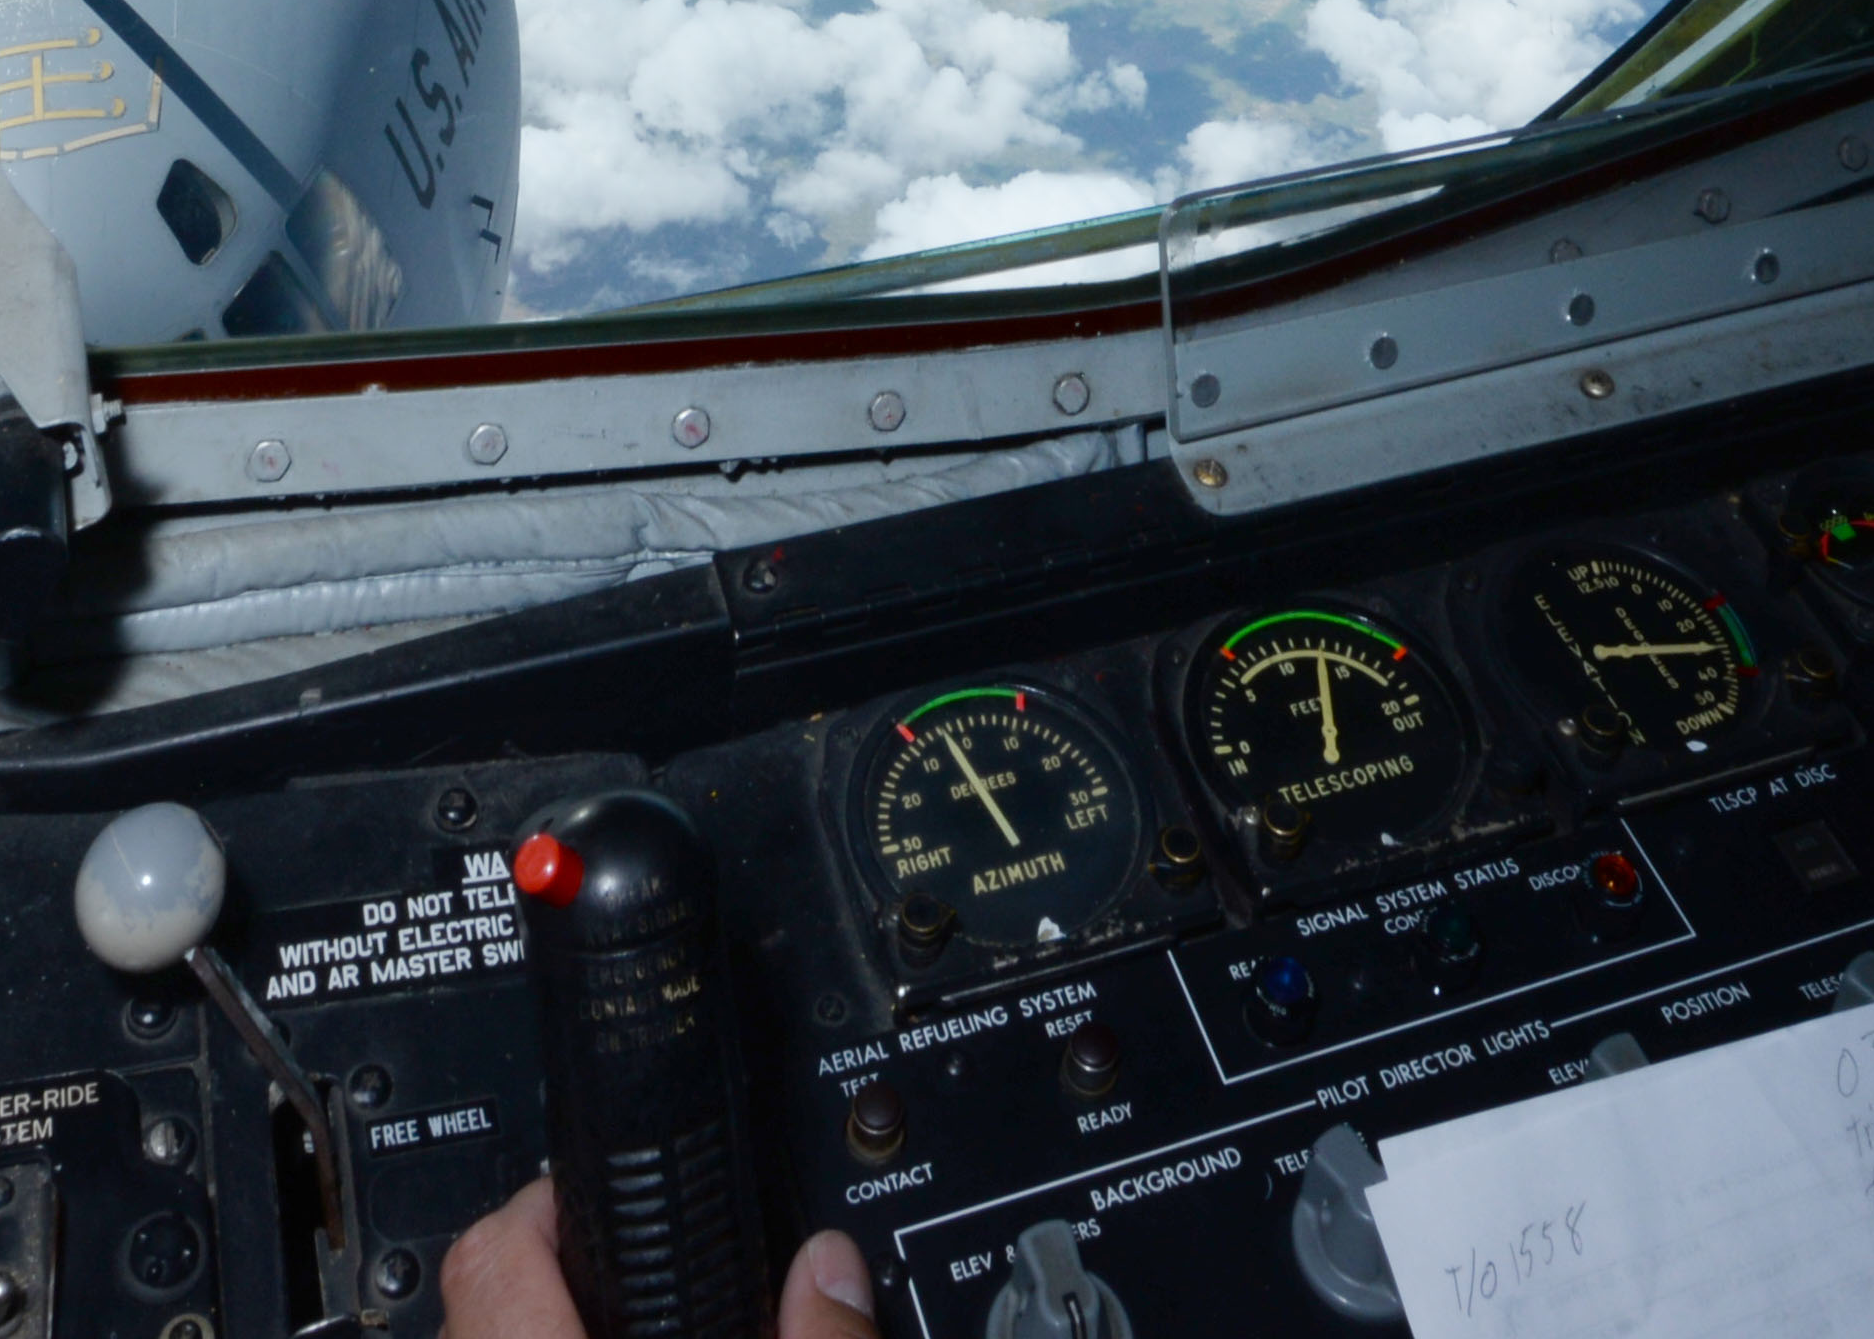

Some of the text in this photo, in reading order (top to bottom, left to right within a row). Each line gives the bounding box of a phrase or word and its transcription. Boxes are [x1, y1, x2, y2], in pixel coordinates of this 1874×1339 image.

[385, 48, 462, 209] U.S.
[1676, 618, 1695, 634] 20
[1279, 661, 1295, 677] 10
[1335, 664, 1351, 679] 15
[1381, 700, 1400, 717] 20
[1393, 711, 1424, 733] OUT
[1676, 708, 1723, 736] DOWN
[1003, 735, 1019, 752] 10
[923, 757, 940, 774] 10
[1041, 755, 1061, 772] 20
[1229, 758, 1247, 777] IN
[1279, 755, 1414, 806] TELESCOPING
[1708, 764, 1837, 815] TLSCP AT DISC
[902, 792, 922, 809] 20
[1070, 789, 1090, 807] 30
[1064, 804, 1109, 830] LEFT
[902, 836, 922, 854] 30
[896, 846, 952, 879] RIGHT
[972, 852, 1066, 896] AZIMUTH
[363, 892, 453, 926] DO NOT
[1296, 857, 1521, 937] SIGNAL SYSTEM STATUS
[279, 913, 514, 969] WITHOUT ELECTRIC
[266, 947, 472, 1000] AND AR MASTER
[1660, 980, 1751, 1025] POSITION
[818, 981, 1098, 1077] AERIAL REFUELING SYSTEM
[1045, 1010, 1094, 1039] RESET
[1316, 1019, 1552, 1110] PILOT DIRECTOR LIGHTS
[370, 1106, 492, 1149] FREE WHEEL
[1077, 1102, 1134, 1135] READY
[845, 1162, 935, 1205] CONTACT
[1090, 1146, 1242, 1212] BACKGROUND
[949, 1251, 994, 1283] ELEV
